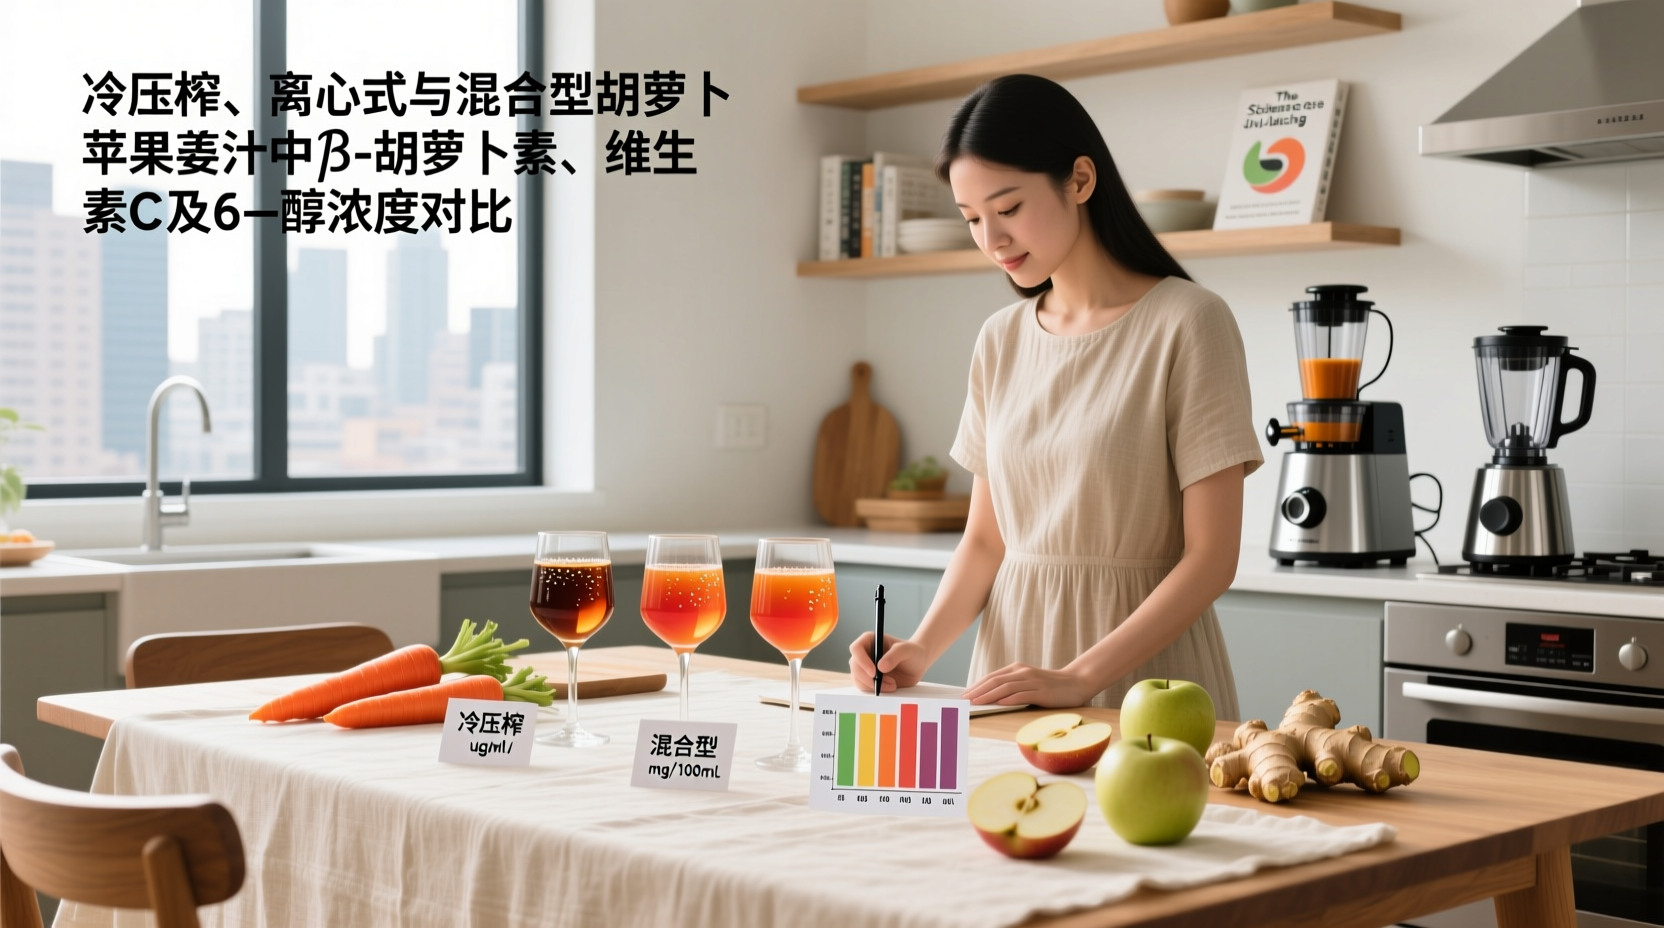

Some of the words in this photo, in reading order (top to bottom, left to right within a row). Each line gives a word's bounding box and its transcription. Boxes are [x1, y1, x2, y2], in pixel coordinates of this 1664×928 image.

[457, 710, 525, 737] 冷压榨
[650, 733, 718, 759] 混合型
[648, 761, 721, 780] mg/100mL
